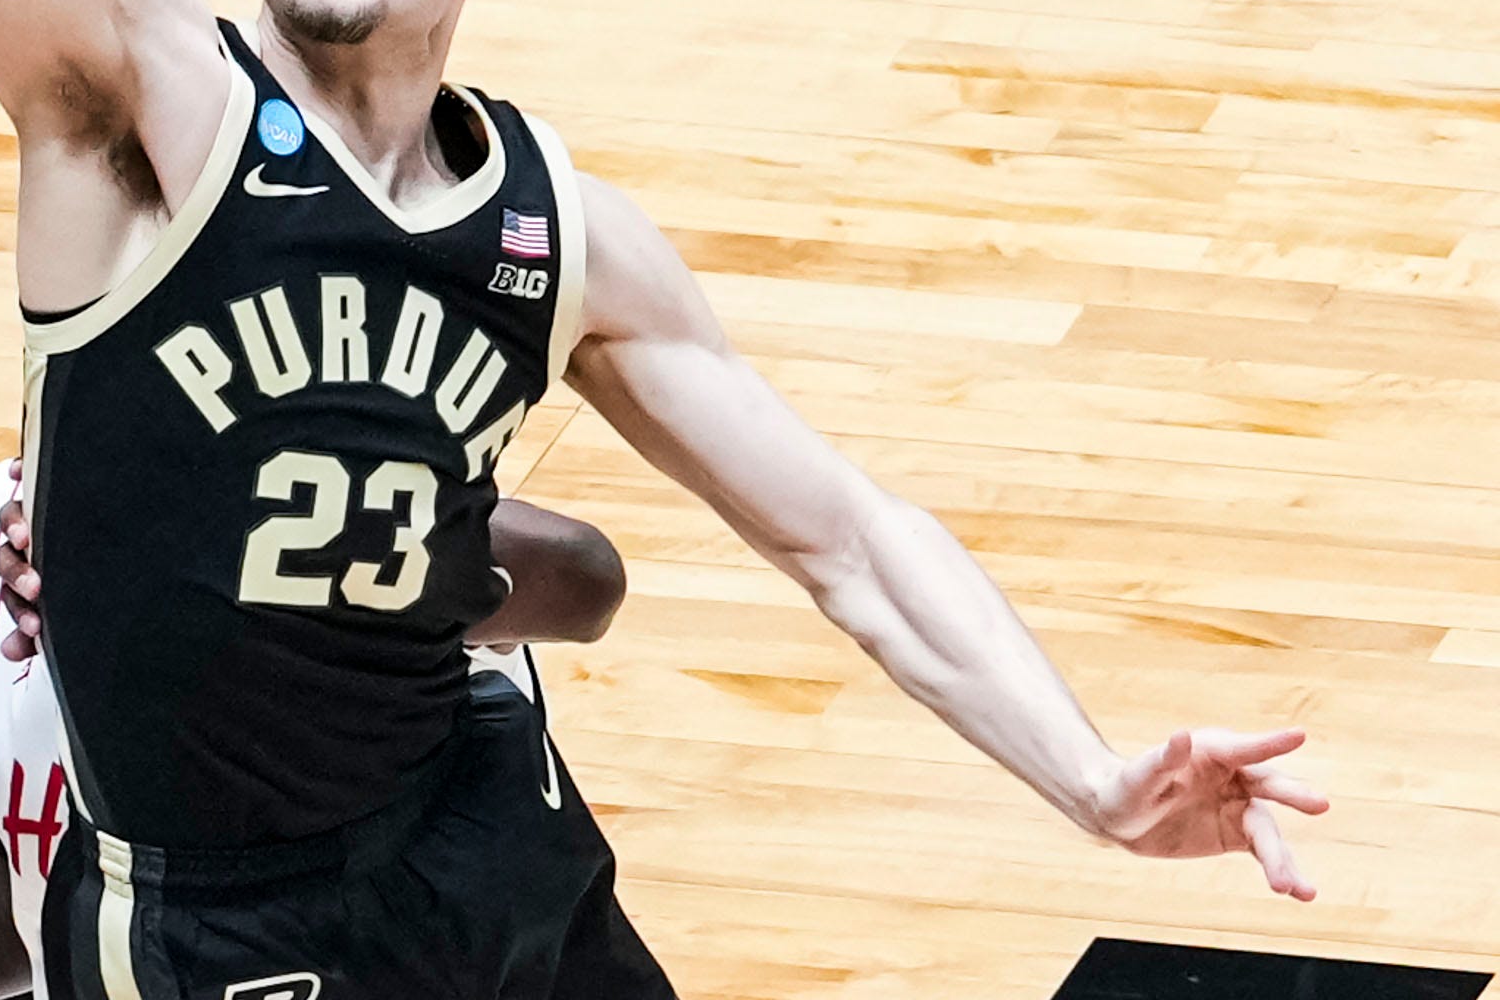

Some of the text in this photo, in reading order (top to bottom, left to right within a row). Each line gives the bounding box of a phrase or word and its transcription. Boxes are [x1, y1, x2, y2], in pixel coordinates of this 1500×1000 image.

[487, 262, 549, 300] BIG
[152, 273, 526, 484] PURDUE
[237, 449, 439, 612] 23
